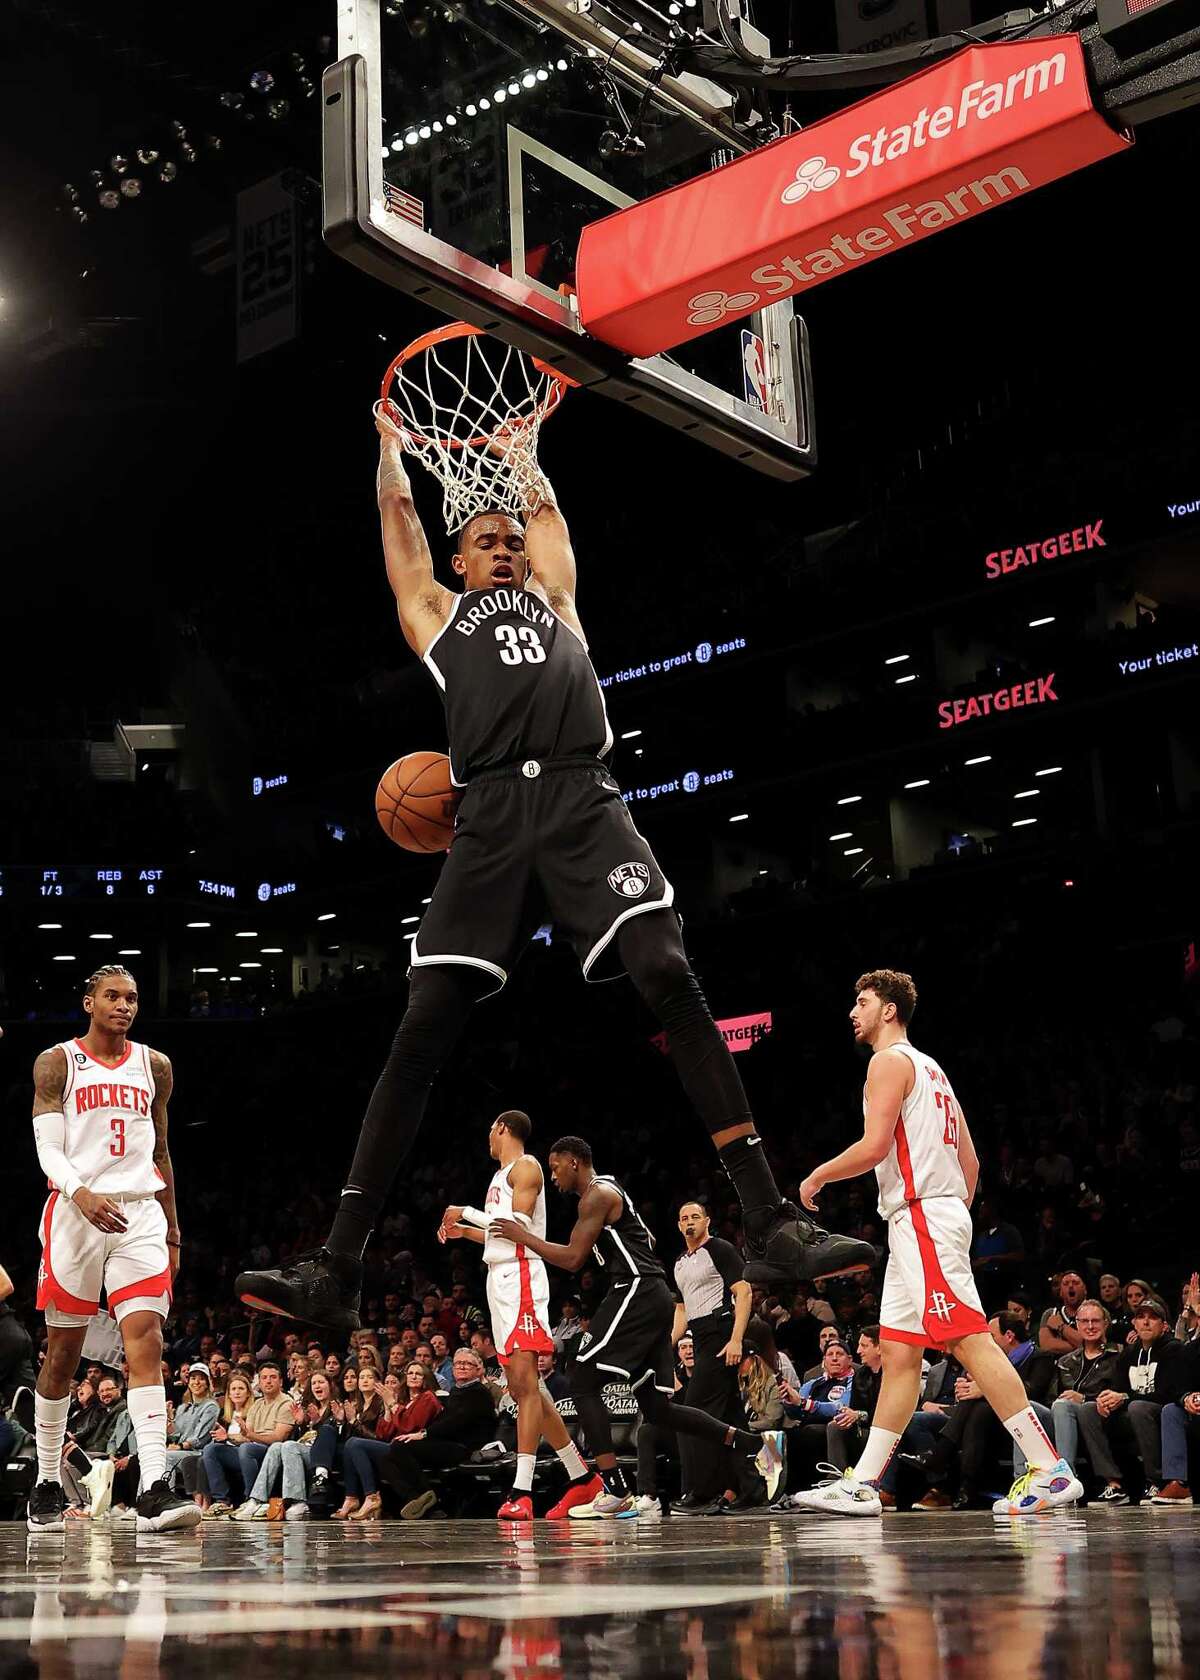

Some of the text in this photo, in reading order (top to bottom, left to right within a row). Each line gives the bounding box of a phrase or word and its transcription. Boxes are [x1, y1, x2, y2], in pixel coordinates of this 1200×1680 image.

[1168, 500, 1200, 518] Your
[985, 520, 1106, 579] SEATGEEK
[455, 590, 554, 636] BROOKLYN
[495, 625, 547, 665] 33
[1119, 644, 1199, 675] Your ticket
[615, 664, 647, 683] ticket
[649, 662, 661, 673] to
[663, 651, 692, 672] great
[716, 638, 746, 655] seats
[938, 673, 1058, 728] SEATGEEK
[265, 774, 288, 789] seats
[636, 788, 648, 799] to
[650, 779, 679, 798] great
[704, 769, 734, 785] seats
[43, 870, 163, 881] FT REB AST
[106, 885, 114, 895] 8
[147, 884, 154, 895] 6
[199, 880, 235, 898] 7:54 PM
[273, 883, 296, 896] seats
[608, 864, 648, 888] NETS
[75, 1084, 149, 1116] ROCKETS
[110, 1119, 125, 1156] 3
